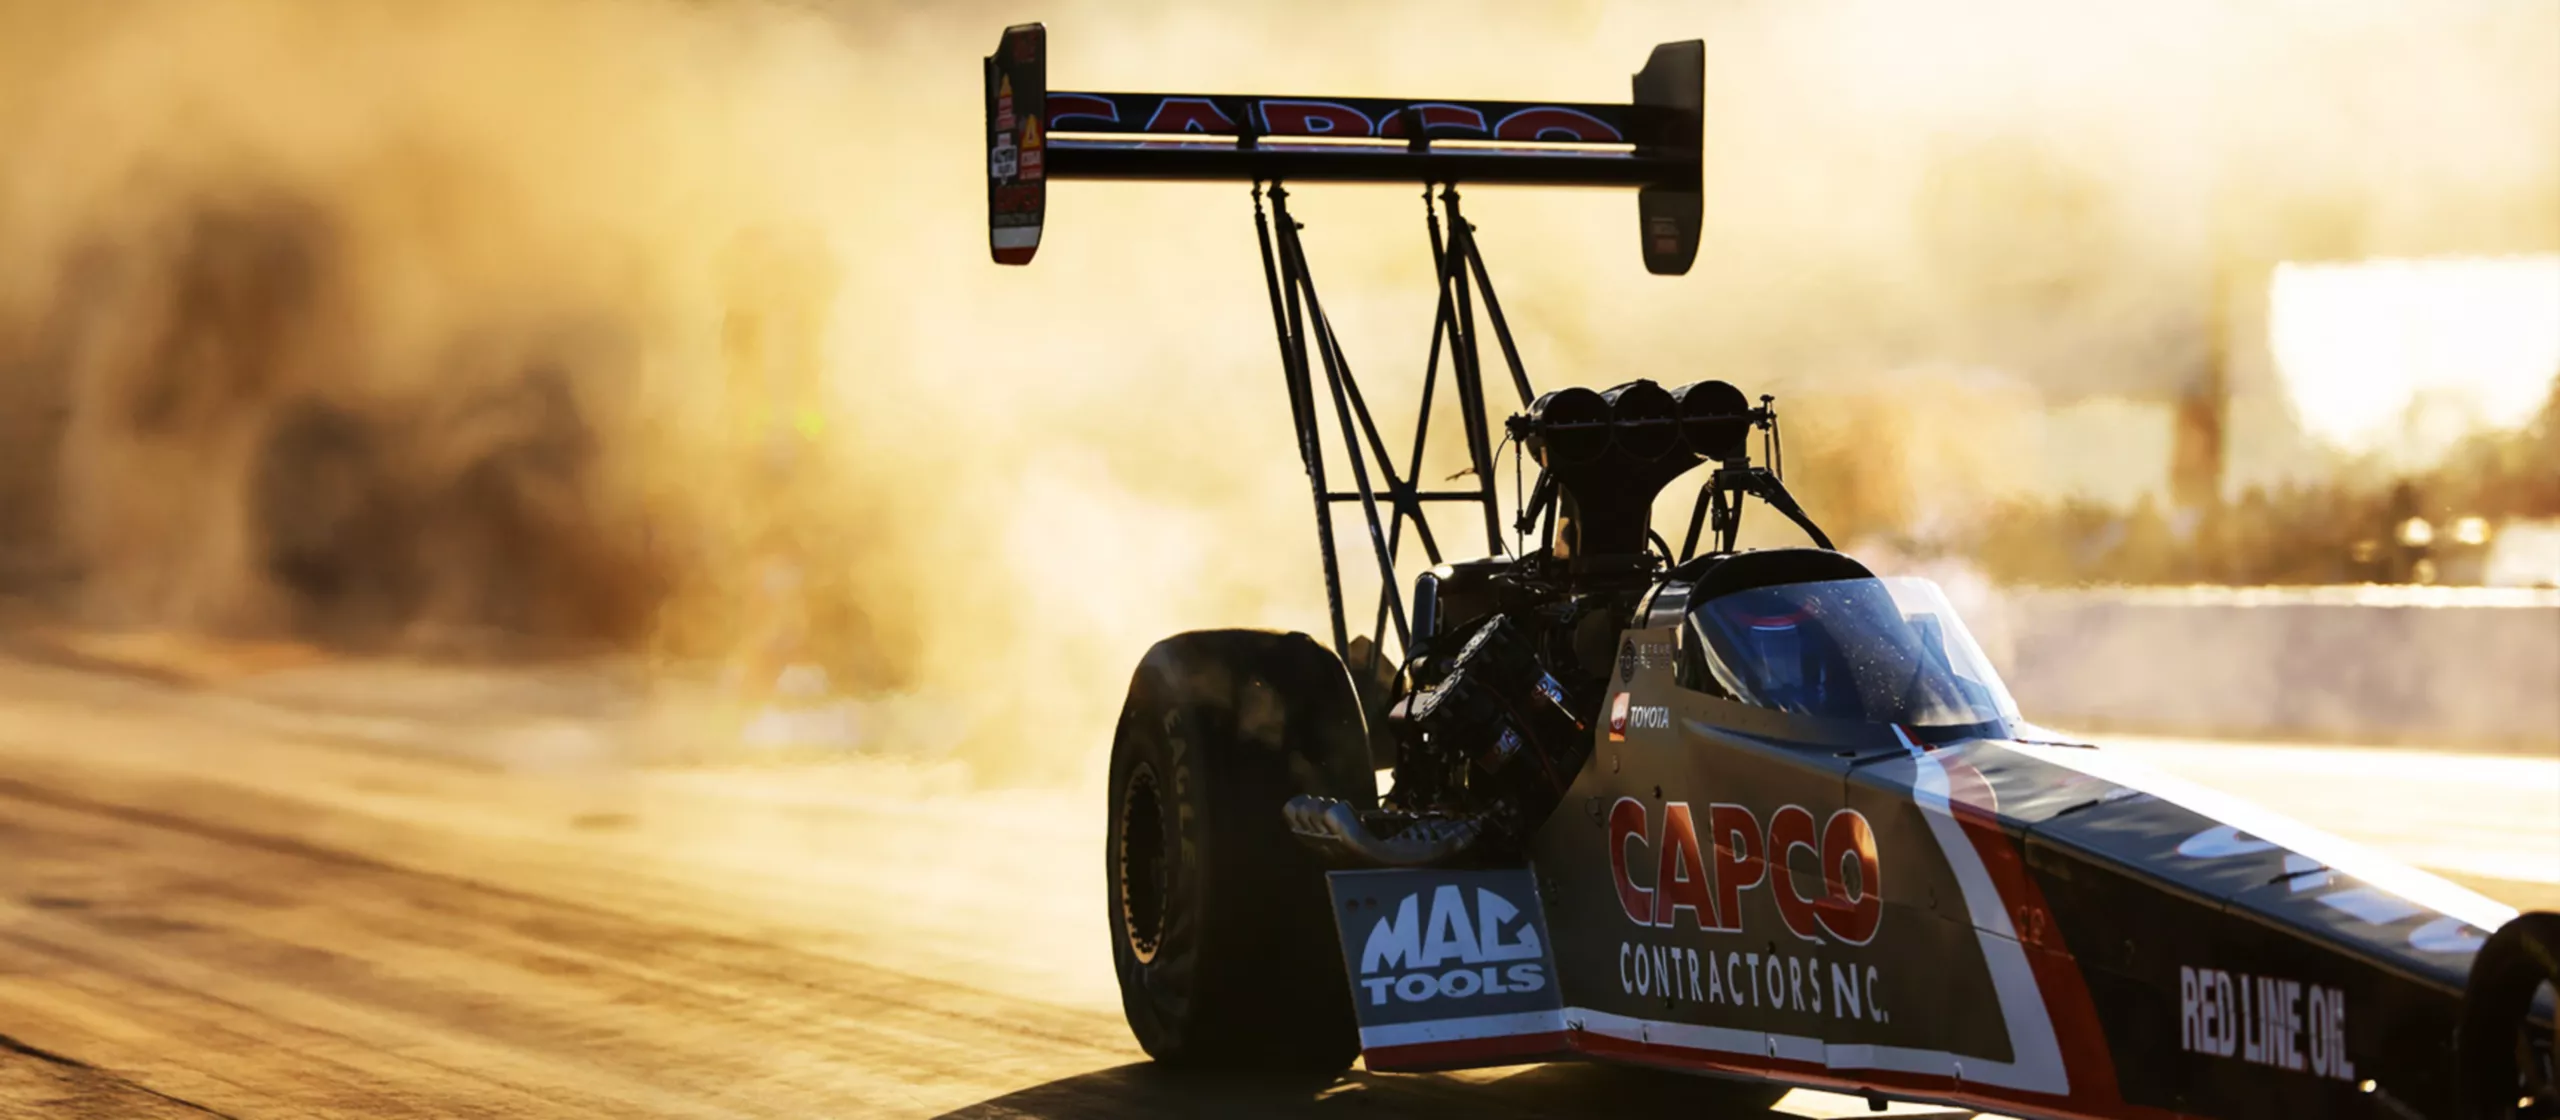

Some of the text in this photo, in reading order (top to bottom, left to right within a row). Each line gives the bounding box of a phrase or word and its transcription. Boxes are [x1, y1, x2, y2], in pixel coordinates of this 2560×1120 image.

[1630, 706, 1670, 729] TOYOTA
[1609, 797, 1883, 946] CAPCO
[1360, 884, 1543, 974] MAC
[1361, 963, 1546, 1006] TOOLS
[1620, 942, 1822, 1014] CONTRACTORS
[2180, 965, 2355, 1082] RED LINE OIL
